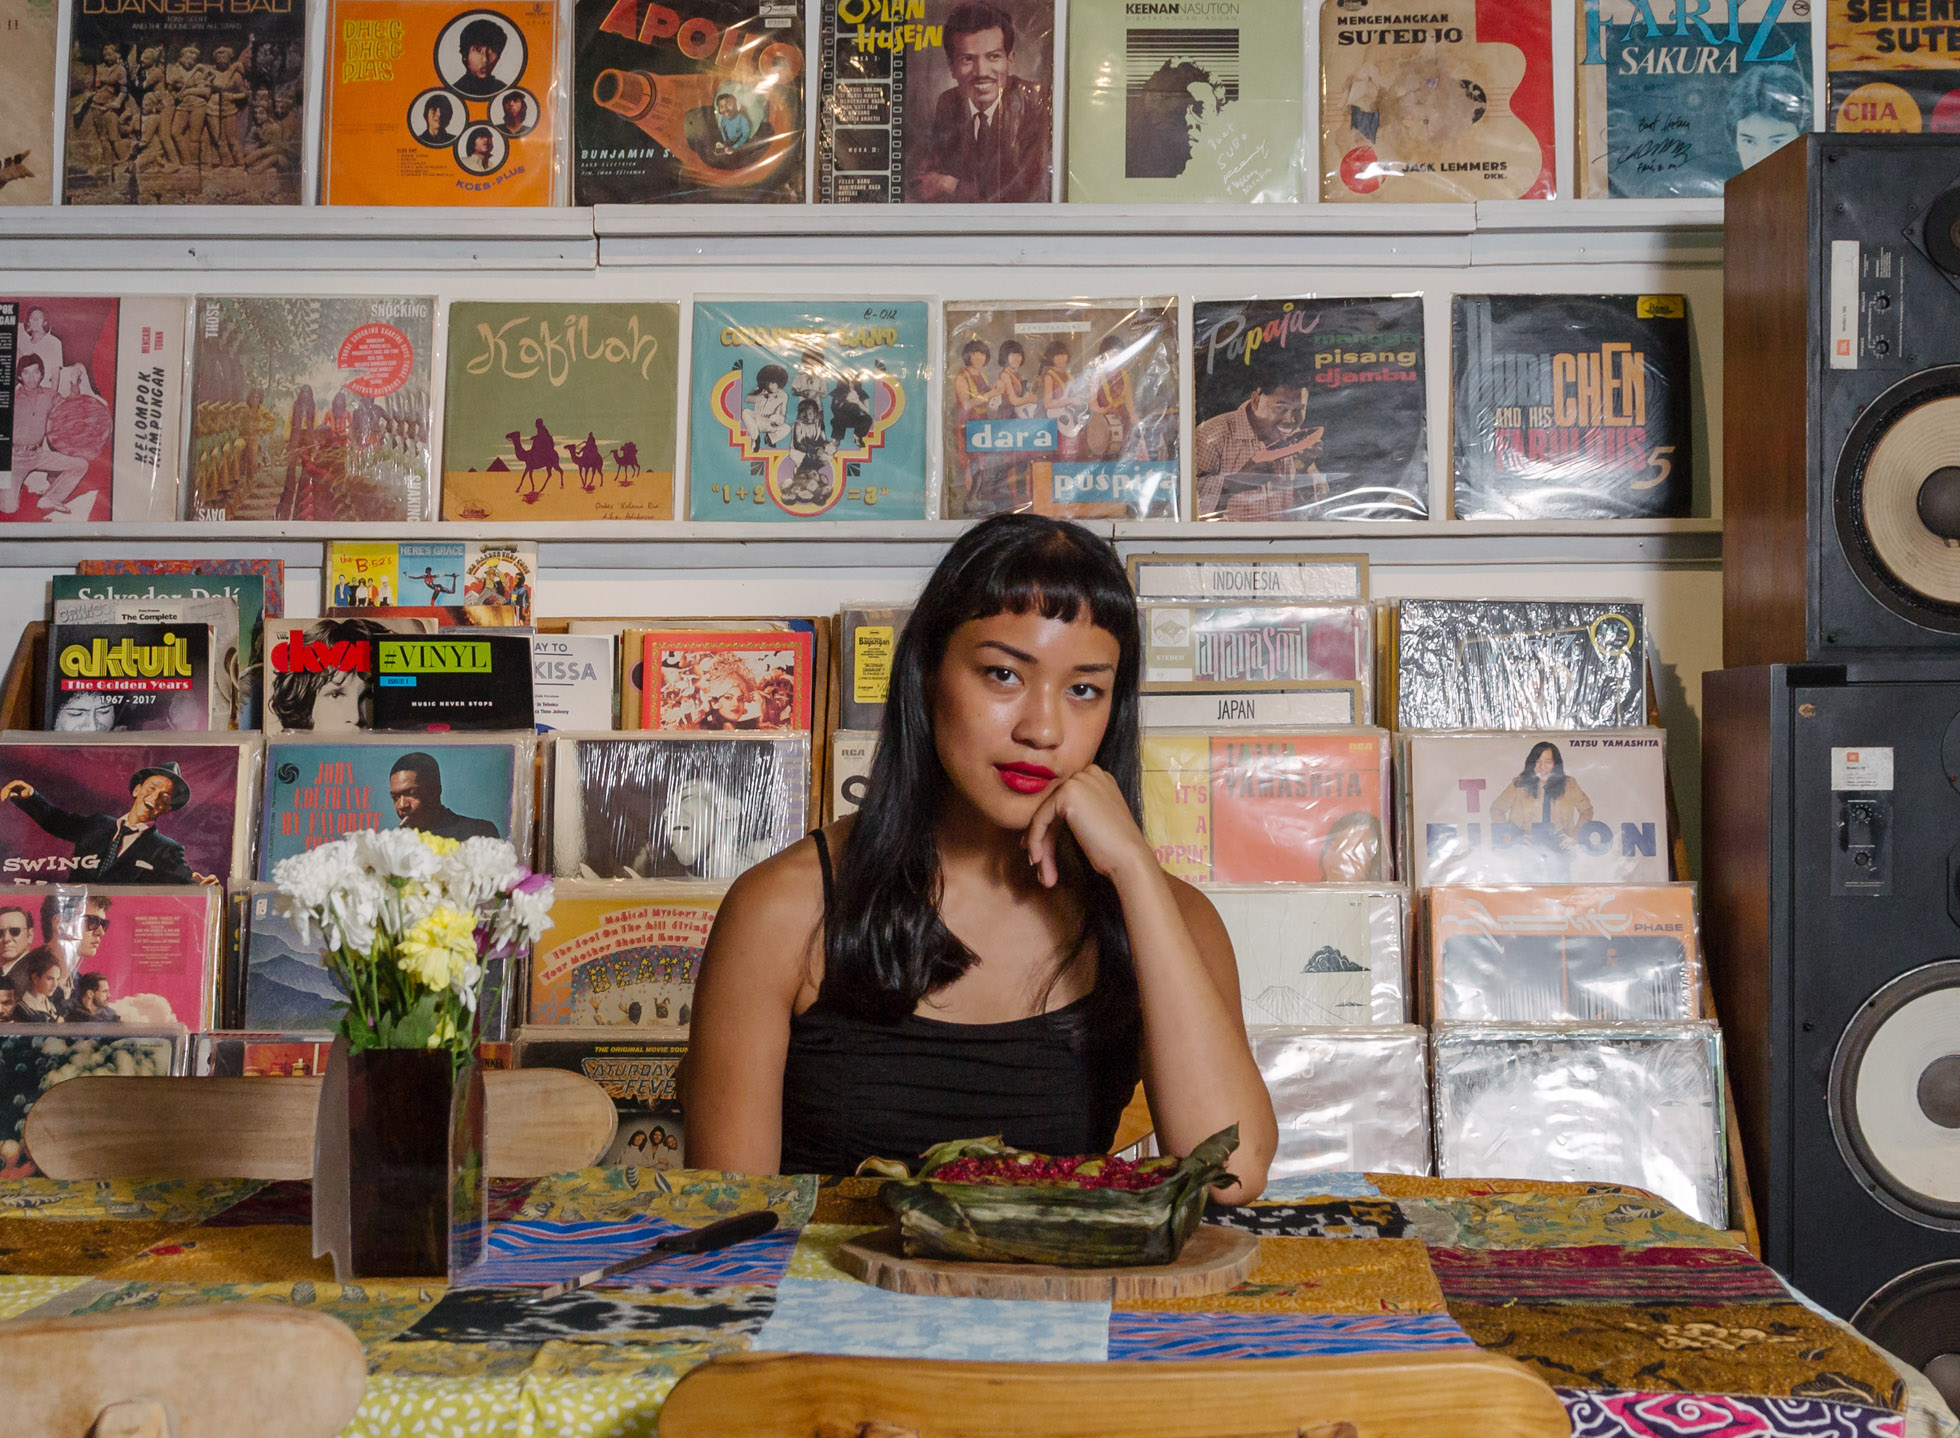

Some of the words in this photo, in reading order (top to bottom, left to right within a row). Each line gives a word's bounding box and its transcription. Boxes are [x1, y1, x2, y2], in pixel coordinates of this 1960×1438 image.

[1337, 14, 1449, 26] MENGENANGKAN
[343, 20, 405, 41] DHEG
[1337, 28, 1463, 47] SUTEDJO
[346, 41, 405, 60] DHEG
[1618, 46, 1738, 76] SAKURA
[342, 61, 395, 84] PLAS
[1843, 102, 1898, 122] CHA
[581, 149, 655, 160] BUNJAMIN
[663, 148, 675, 158] S.
[1401, 162, 1435, 172] JACK
[1440, 161, 1508, 172] LEMMERS
[456, 165, 526, 192] KOES-PLUS
[205, 303, 220, 339] THOSE
[371, 303, 427, 319] SHOCKING
[1198, 302, 1322, 376] Papaja
[1315, 349, 1417, 369] pisang
[1314, 368, 1417, 388] djambu
[1553, 342, 1647, 427] CHEN
[134, 371, 152, 464] KELOMPOK
[148, 366, 166, 468] KAMPUNGAN
[1494, 407, 1522, 428] AND
[1528, 407, 1552, 428] HIS
[970, 423, 1053, 449] dara
[1629, 445, 1676, 490] 5
[400, 546, 430, 556] HERE'S
[433, 546, 464, 556] GRACE
[1212, 571, 1281, 591] INDONESIA
[121, 613, 138, 621] The
[139, 613, 178, 623] Complete
[383, 644, 488, 670] #VINYL
[551, 643, 568, 652] TO
[534, 661, 598, 681] KISSA
[66, 679, 94, 689] The
[99, 679, 147, 690] Golden
[150, 679, 190, 691] Years
[100, 694, 125, 705] 1967
[132, 694, 157, 705] 2017
[411, 700, 437, 708] MUSIC
[439, 700, 465, 708] NEVER
[468, 700, 494, 708] STOPS
[1217, 699, 1256, 721] JAPAN
[841, 749, 865, 757] RCA
[1569, 740, 1599, 748] TATSU
[1602, 740, 1660, 748] YAMASHITA
[314, 761, 355, 785] JOHN
[1174, 785, 1208, 805] IT'S
[1224, 771, 1363, 799] YAMASHITA
[294, 785, 373, 811] COLTRANE
[281, 812, 300, 835] MY
[308, 811, 384, 835] FAVORITE
[1195, 815, 1208, 835] A
[3, 854, 101, 873] SWING
[604, 908, 649, 925] Magical
[651, 908, 698, 920] Mystery
[1634, 923, 1684, 932] PHASE
[551, 945, 574, 960] The
[602, 927, 619, 939] On
[619, 922, 642, 935] The
[542, 962, 568, 980] Your
[569, 943, 612, 964] Mother
[614, 932, 654, 948] Should
[595, 1046, 610, 1054] THE
[610, 1046, 644, 1054] ORIGINAL
[645, 1046, 669, 1054] MOVIE
